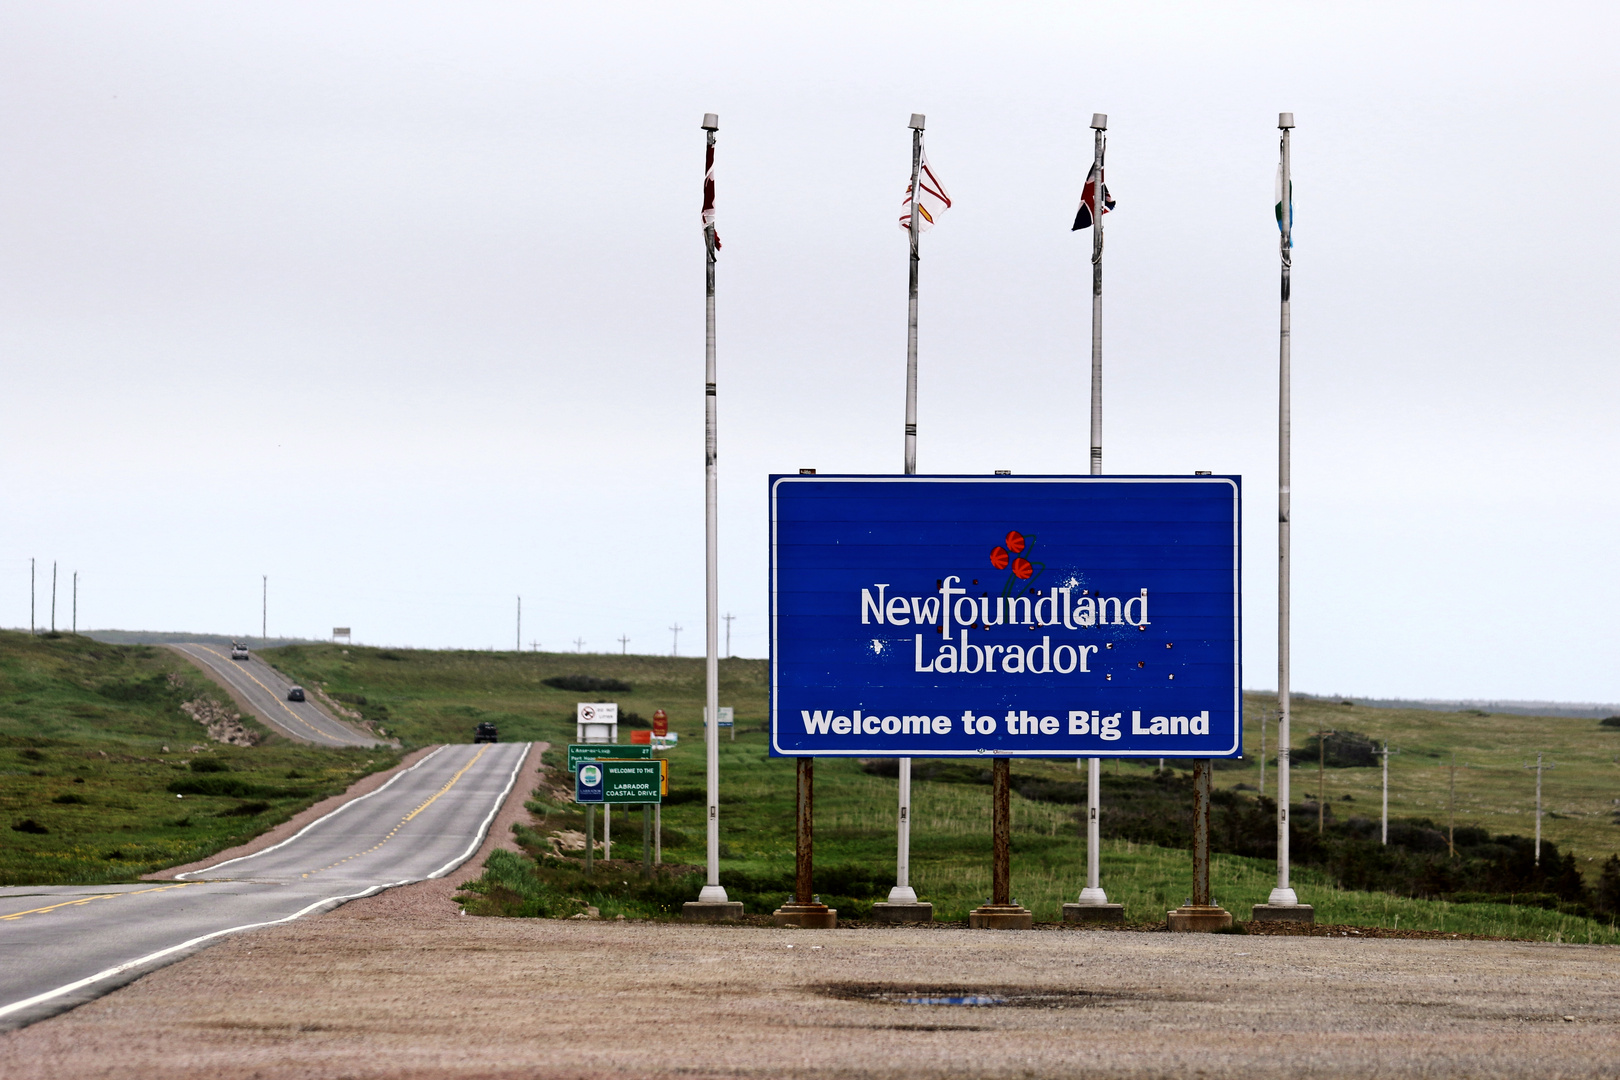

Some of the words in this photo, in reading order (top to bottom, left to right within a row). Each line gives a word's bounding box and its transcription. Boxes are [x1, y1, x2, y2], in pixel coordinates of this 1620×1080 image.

[861, 576, 1151, 640] Newfoundland
[915, 629, 1098, 673] Labrador
[801, 711, 951, 735] Welcome
[962, 711, 996, 735] to
[1005, 711, 1059, 735] the
[1069, 711, 1121, 741] Big
[1132, 711, 1209, 735] Land
